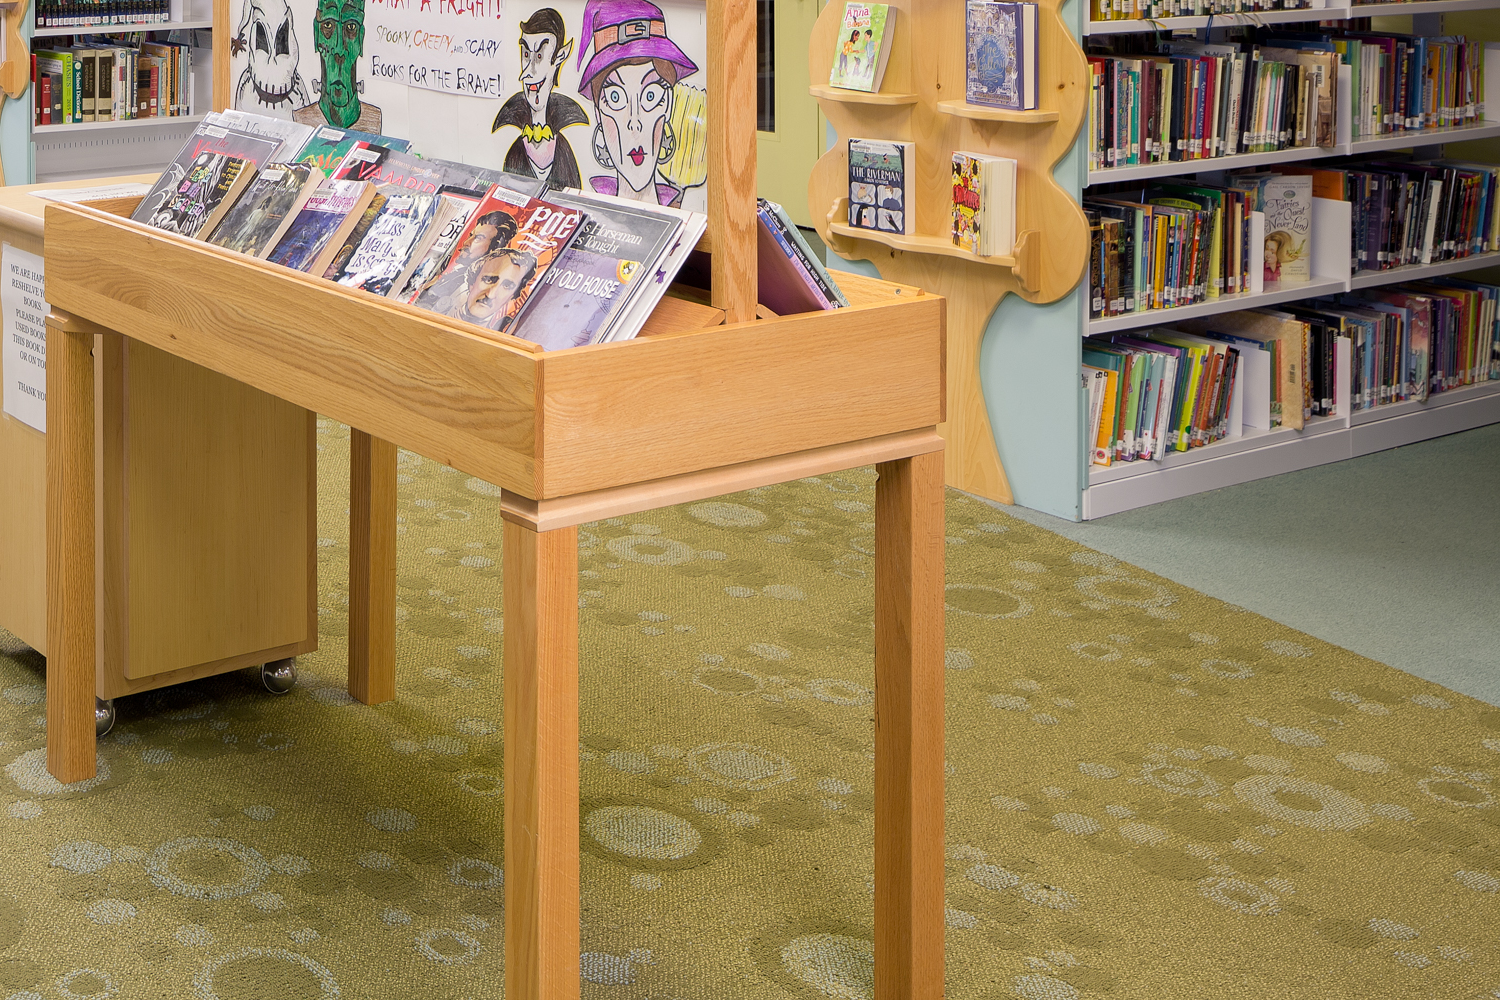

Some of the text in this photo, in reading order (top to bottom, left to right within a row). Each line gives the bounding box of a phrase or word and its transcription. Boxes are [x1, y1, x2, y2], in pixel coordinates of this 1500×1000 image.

[845, 7, 870, 21] Anna
[376, 25, 501, 58] SPOOKY, CREEPY, SCARY
[372, 55, 501, 97] BOOKS FOR THE BRAVE!
[852, 166, 865, 178] THE
[866, 167, 901, 182] RIVERMAN
[518, 206, 580, 239] POE
[591, 222, 643, 246] Horseman
[583, 236, 619, 255] Tonight
[10, 263, 31, 280] WE ARE
[11, 278, 39, 297] RESHELVE
[558, 269, 582, 292] OLD
[579, 273, 621, 300] HOUSE
[23, 296, 42, 311] BOOKS.
[15, 308, 35, 324] PLEASE
[15, 321, 29, 334] USED
[12, 333, 41, 354] THIS BOOK
[19, 350, 37, 365] OR ON
[17, 380, 37, 398] THANK
